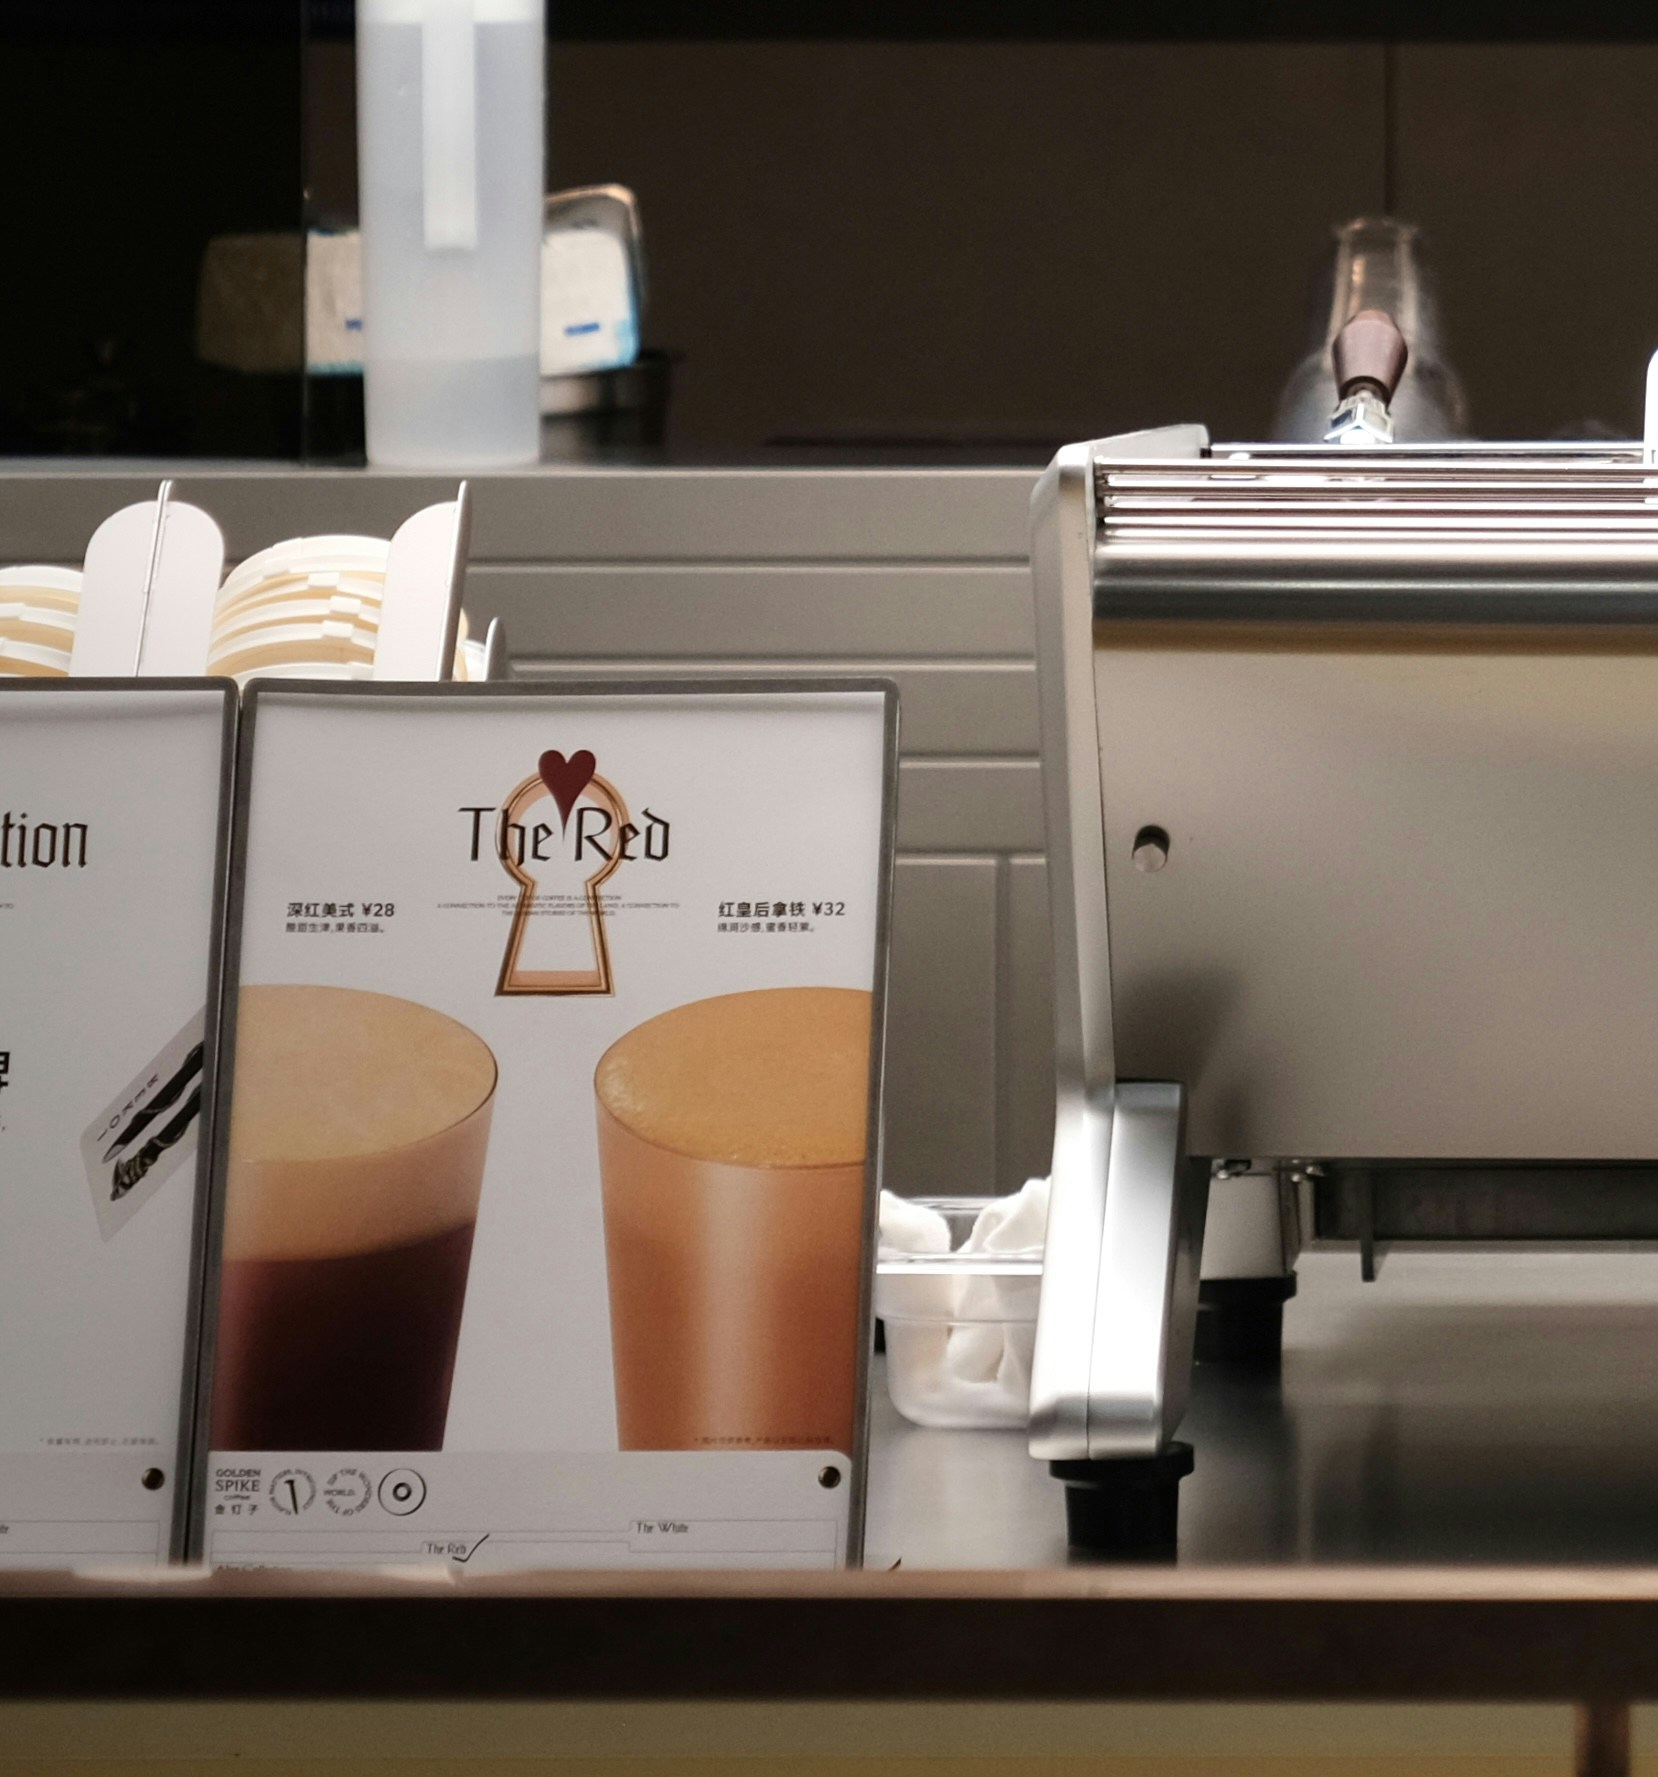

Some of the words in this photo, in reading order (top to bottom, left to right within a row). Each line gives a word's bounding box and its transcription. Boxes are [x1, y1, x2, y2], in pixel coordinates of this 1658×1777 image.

[458, 806, 553, 867] The
[574, 806, 671, 862] Red
[286, 902, 355, 918] 深红美式
[361, 902, 396, 917] ¥28
[718, 901, 806, 918] 红皇后拿铁
[812, 901, 846, 916] ¥32
[215, 1468, 262, 1478] GOLDEN
[214, 1479, 260, 1492] SPIKE
